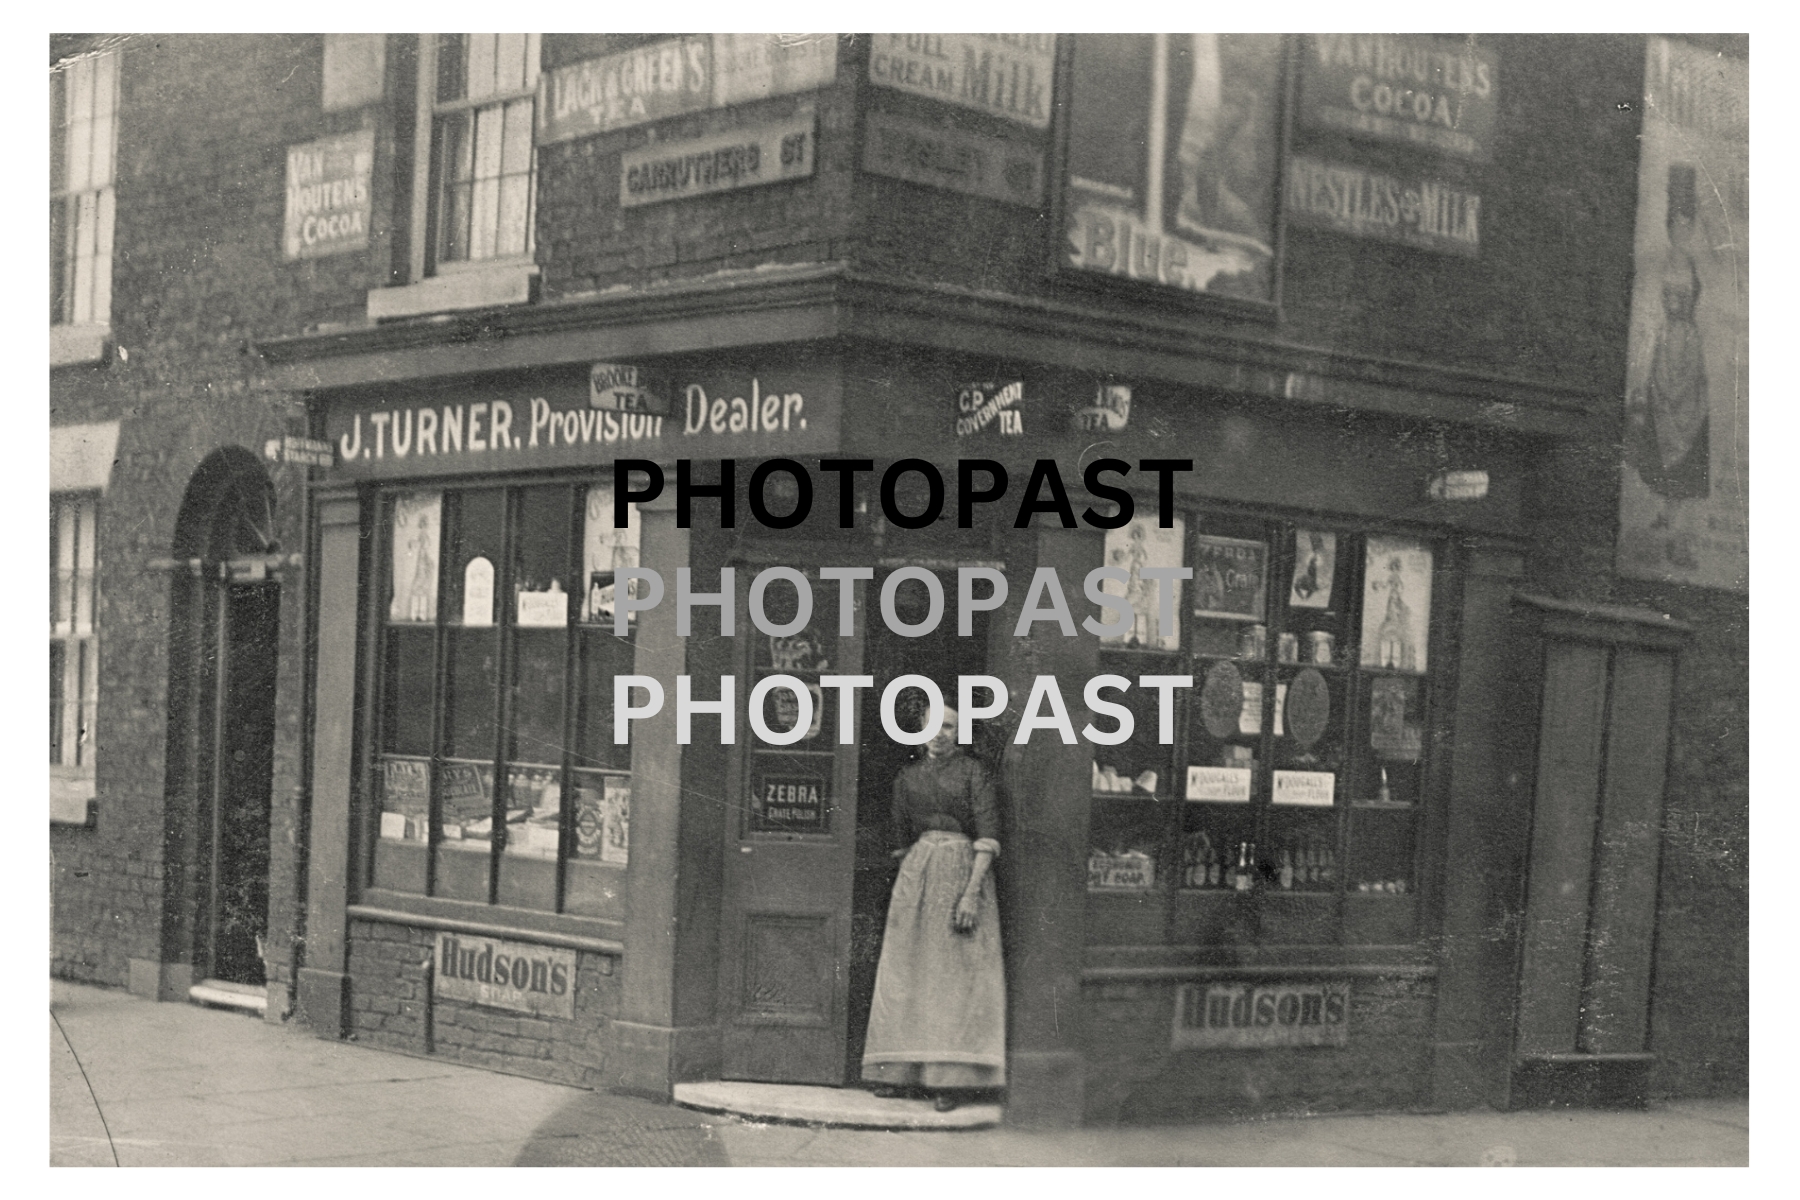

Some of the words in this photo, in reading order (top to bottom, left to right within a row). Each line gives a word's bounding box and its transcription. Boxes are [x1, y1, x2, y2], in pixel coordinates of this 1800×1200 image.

[1351, 76, 1452, 128] COCOA
[302, 211, 363, 246] COCOA
[1083, 219, 1189, 286] Blue
[614, 391, 649, 411] TEA
[684, 377, 807, 436] Dealer.
[998, 409, 1024, 435] TEA
[766, 784, 818, 803] ZEBRA
[441, 937, 569, 996] Hudson's
[1181, 986, 1346, 1029] Hudson's
